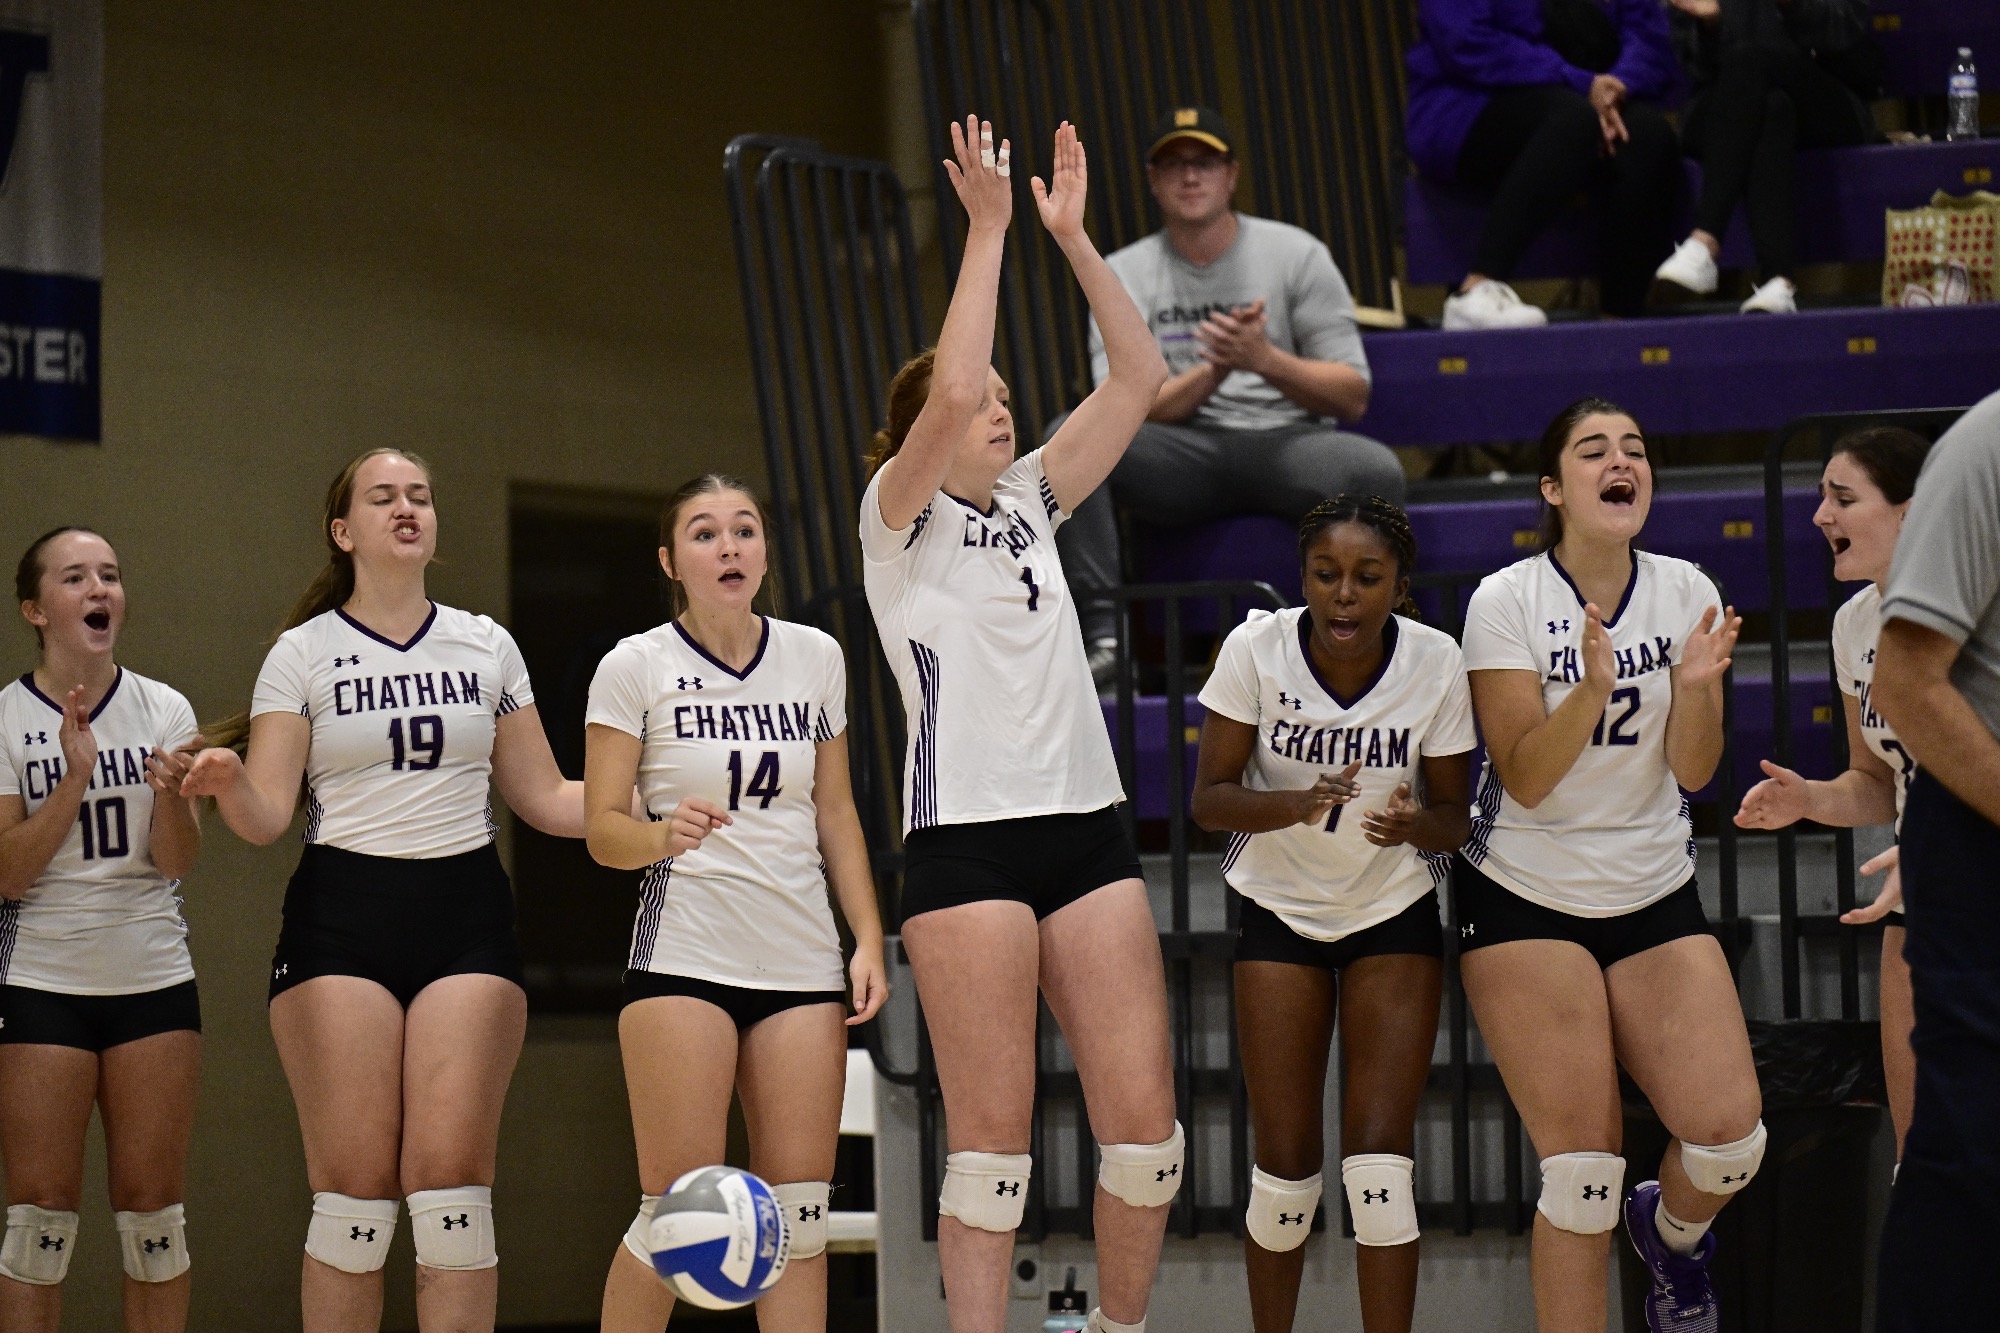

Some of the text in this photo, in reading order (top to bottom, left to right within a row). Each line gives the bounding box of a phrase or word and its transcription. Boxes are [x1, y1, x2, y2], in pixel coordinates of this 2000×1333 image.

[1158, 301, 1252, 324] chat
[1020, 566, 1040, 612] 1
[1547, 636, 1672, 684] CHHAM
[334, 671, 482, 716] CHATHAM
[388, 714, 444, 771] 19
[674, 702, 813, 742] CHATHAM
[1270, 719, 1411, 768] CHATHAM
[26, 746, 156, 800] CHHA
[727, 750, 783, 811] 14
[78, 796, 129, 860] 10
